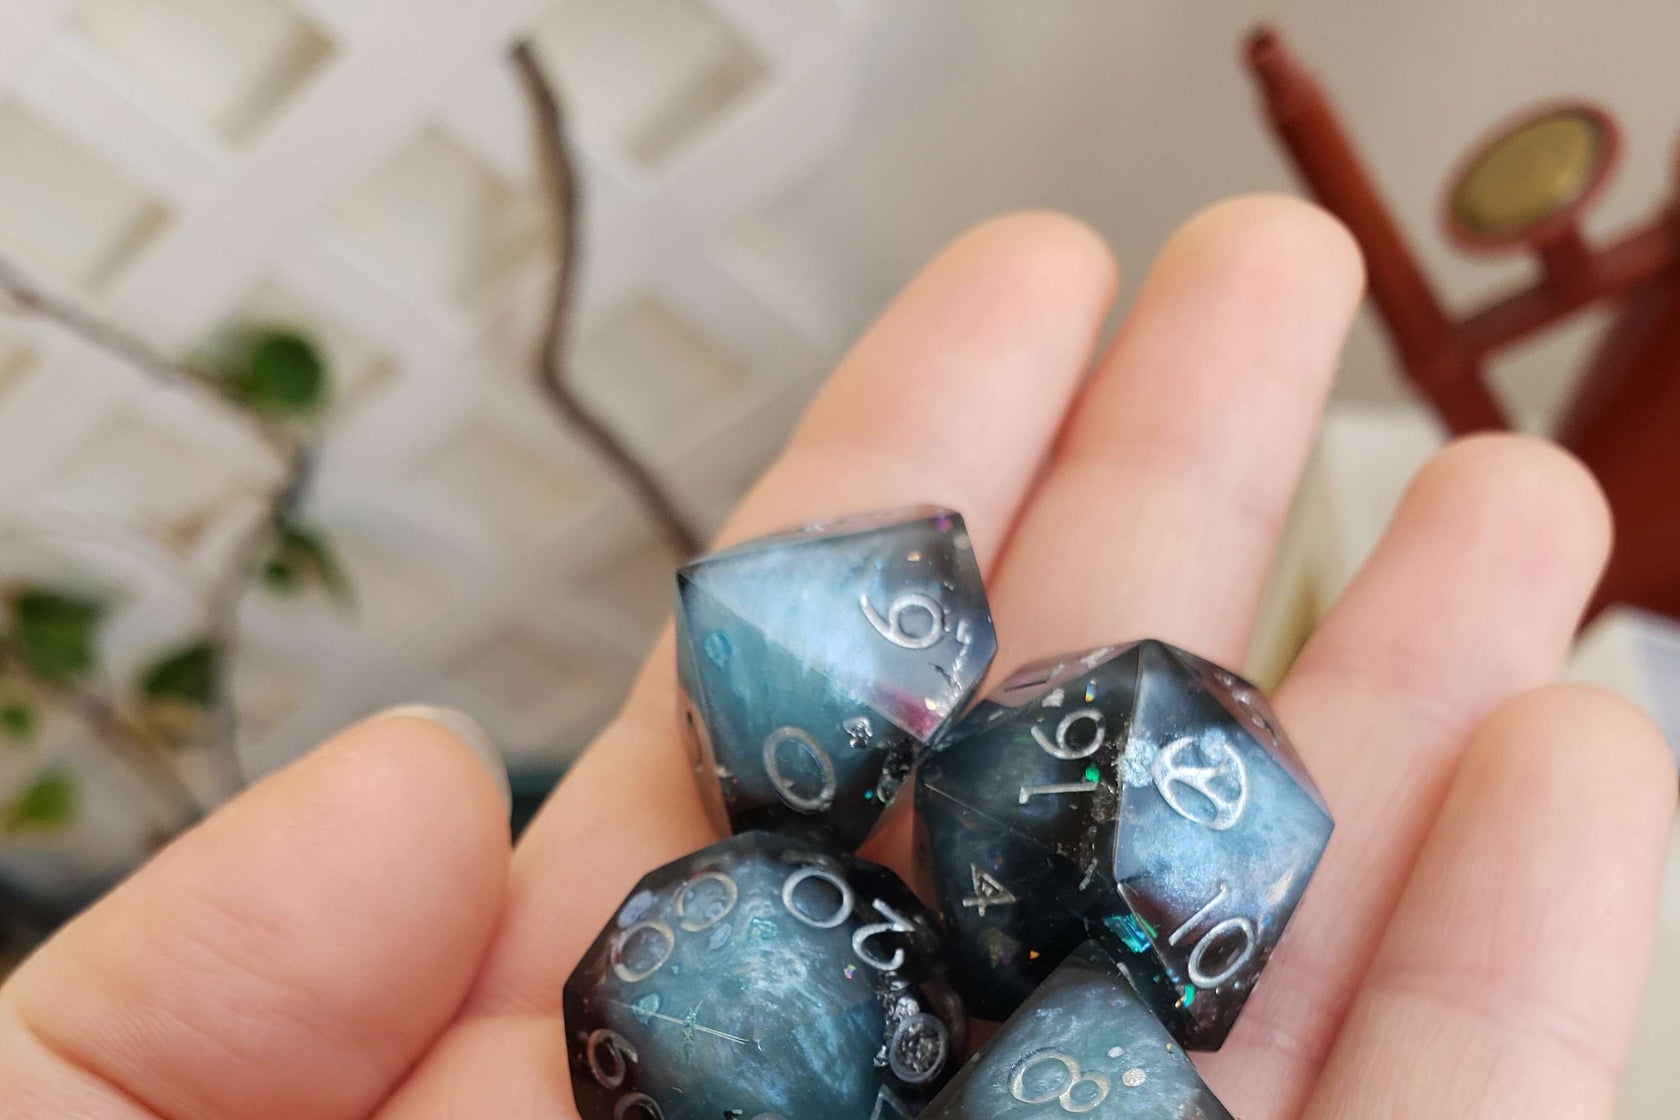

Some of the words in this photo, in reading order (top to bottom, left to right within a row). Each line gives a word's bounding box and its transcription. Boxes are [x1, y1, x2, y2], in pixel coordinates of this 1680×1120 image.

[962, 862, 1017, 918] 4
[1168, 883, 1256, 990] 10
[1007, 1045, 1112, 1114] 8
